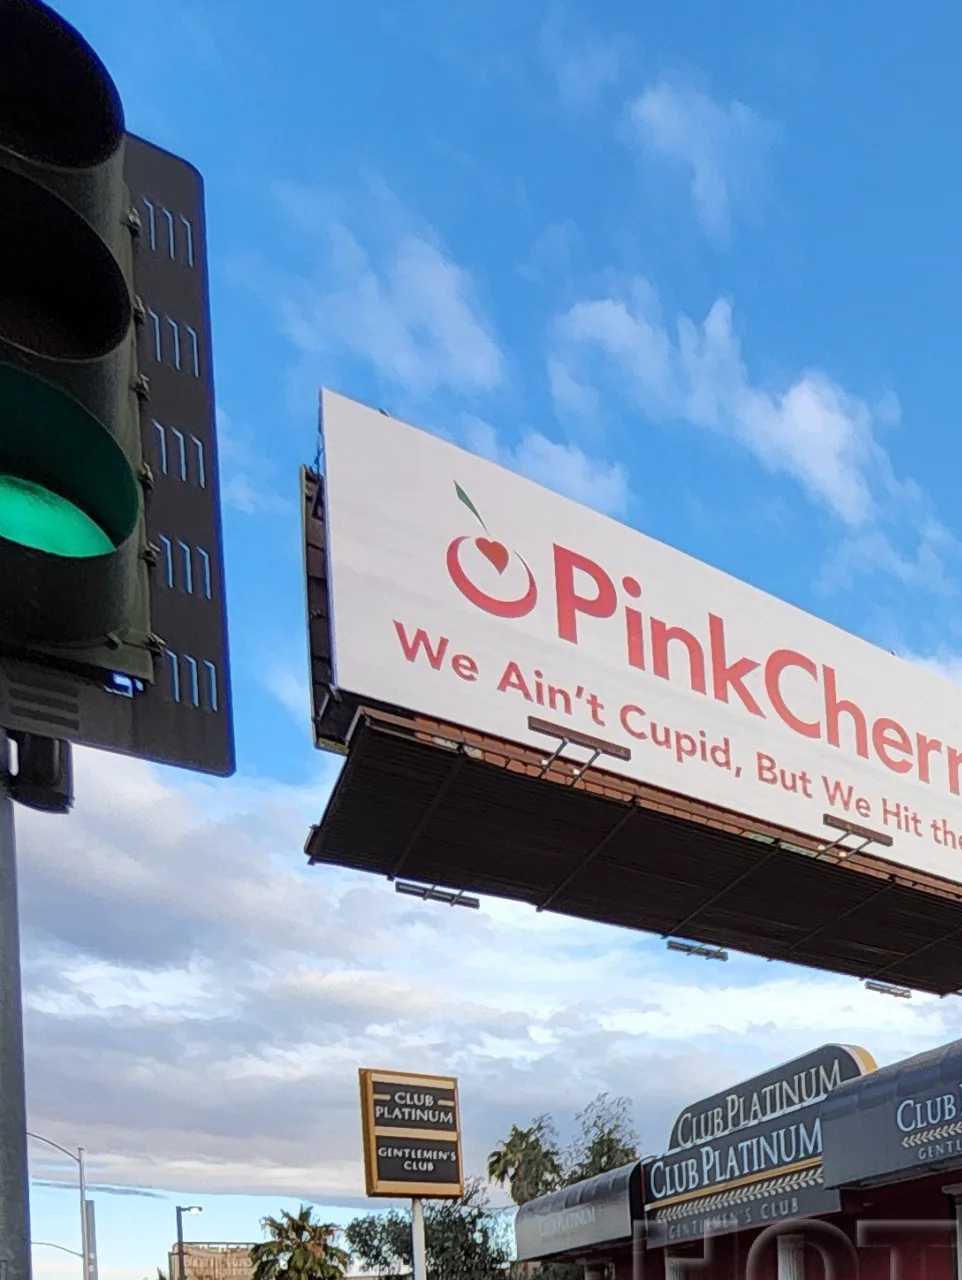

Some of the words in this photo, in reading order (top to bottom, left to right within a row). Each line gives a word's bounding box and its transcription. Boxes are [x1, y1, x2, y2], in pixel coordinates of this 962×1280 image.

[393, 619, 479, 682] We
[497, 661, 606, 727] Ain't
[620, 704, 742, 778] Cupid,
[756, 751, 812, 799] But
[822, 776, 871, 818] We
[882, 798, 923, 837] Hit
[394, 1091, 435, 1107] CLUB
[677, 1107, 725, 1148] CLUB
[726, 1058, 842, 1134] PLATINUM
[375, 1105, 453, 1124] PLATINUM
[897, 1094, 957, 1132] CLUB
[378, 1147, 456, 1161] GENTLEMEN'S
[651, 1158, 699, 1199] CLUB
[700, 1117, 823, 1185] PLATINUM
[403, 1160, 435, 1172] CLUB
[760, 1197, 799, 1220] CLUB
